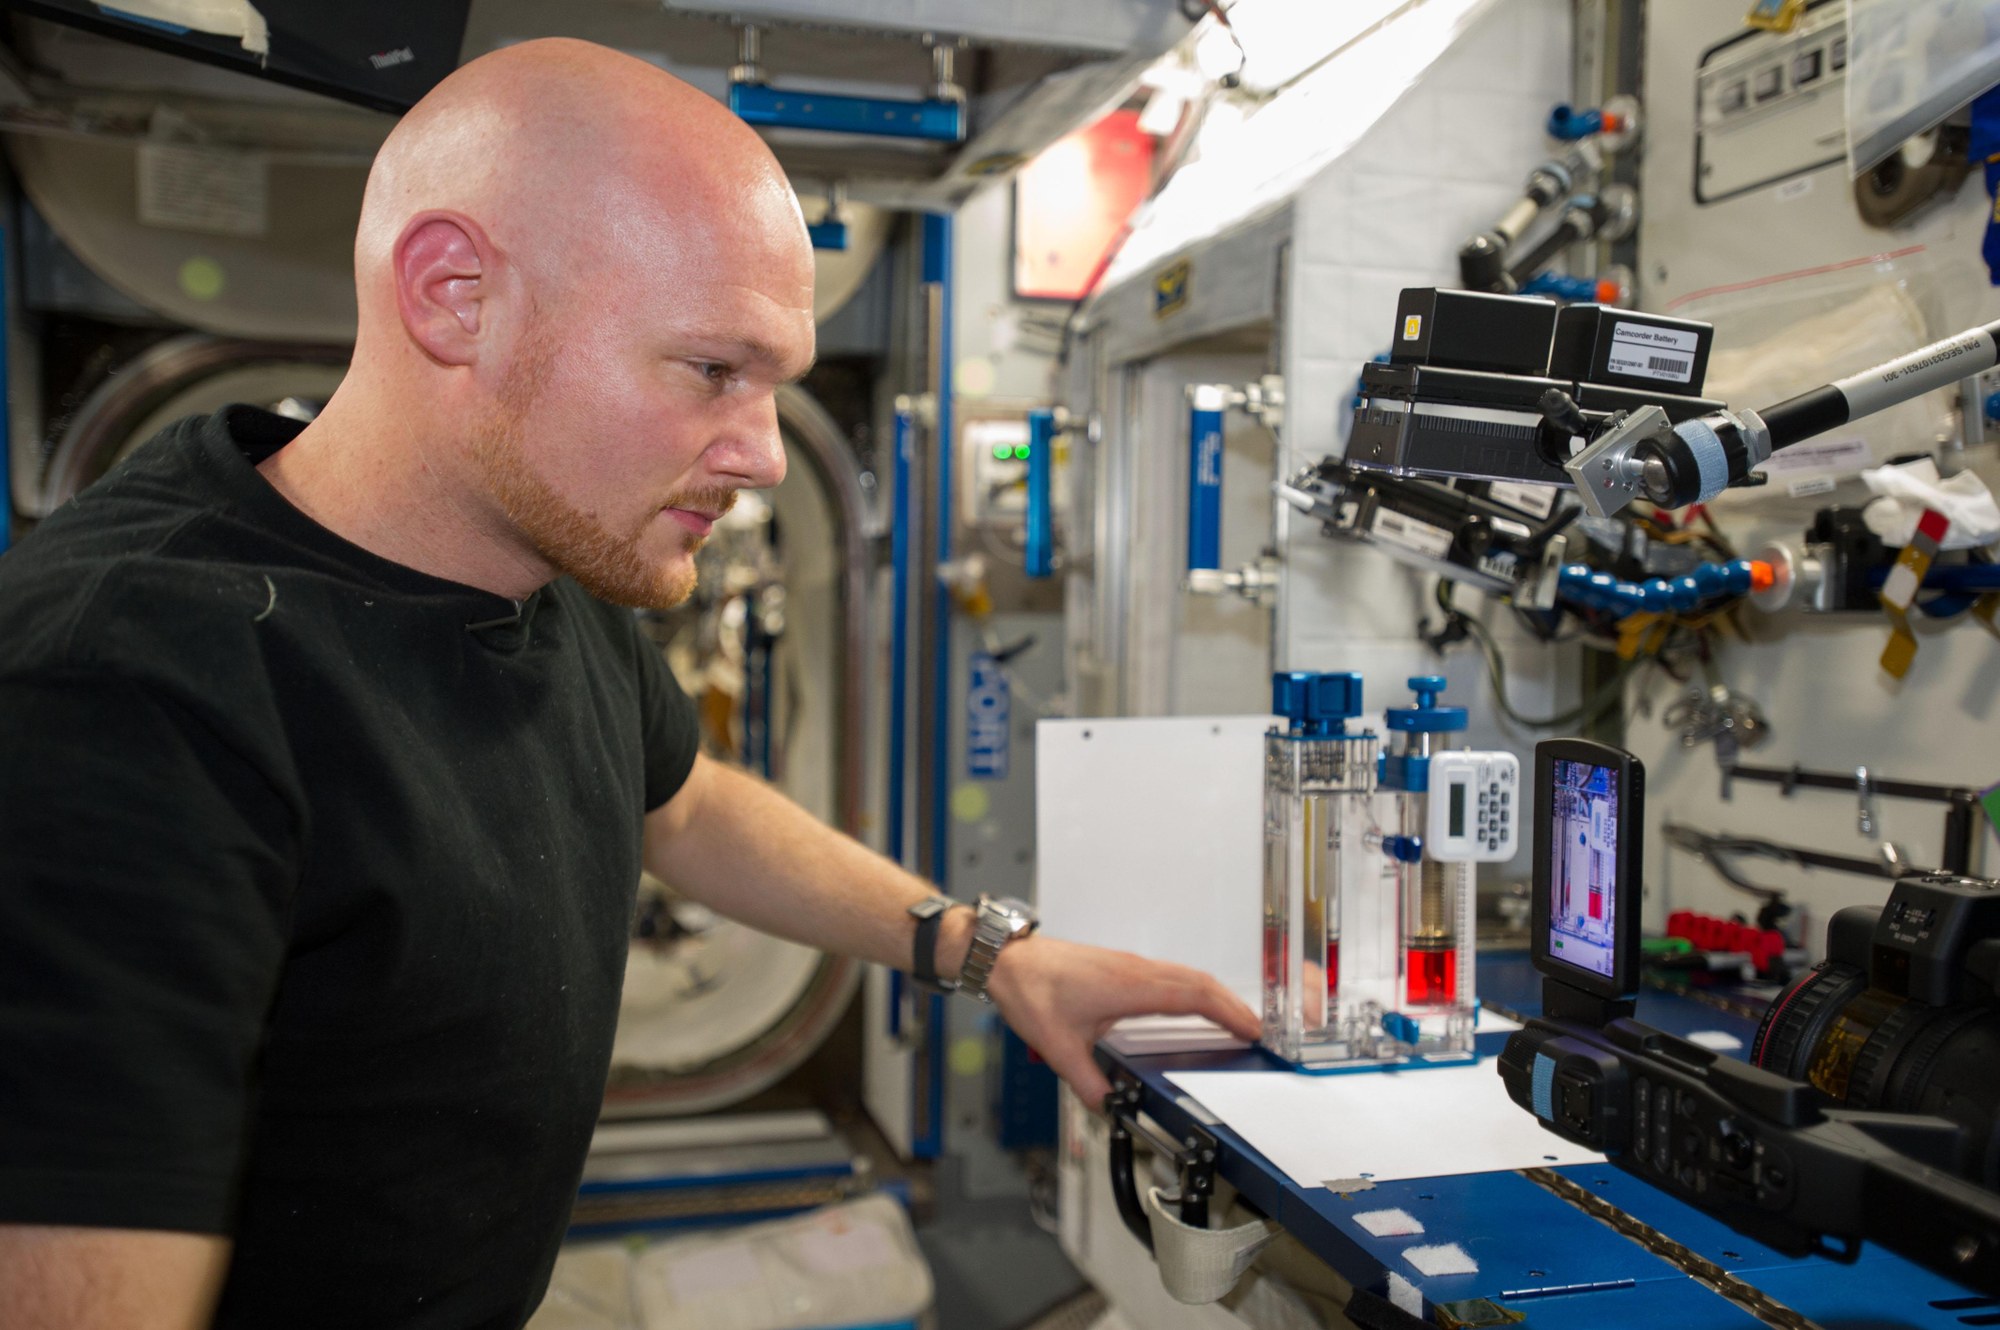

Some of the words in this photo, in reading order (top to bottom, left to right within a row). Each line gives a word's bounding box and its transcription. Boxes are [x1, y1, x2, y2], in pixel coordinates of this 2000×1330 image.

[1615, 328, 1652, 340] Camcorder
[1654, 333, 1678, 345] Battery
[1964, 339, 1981, 352] P/N
